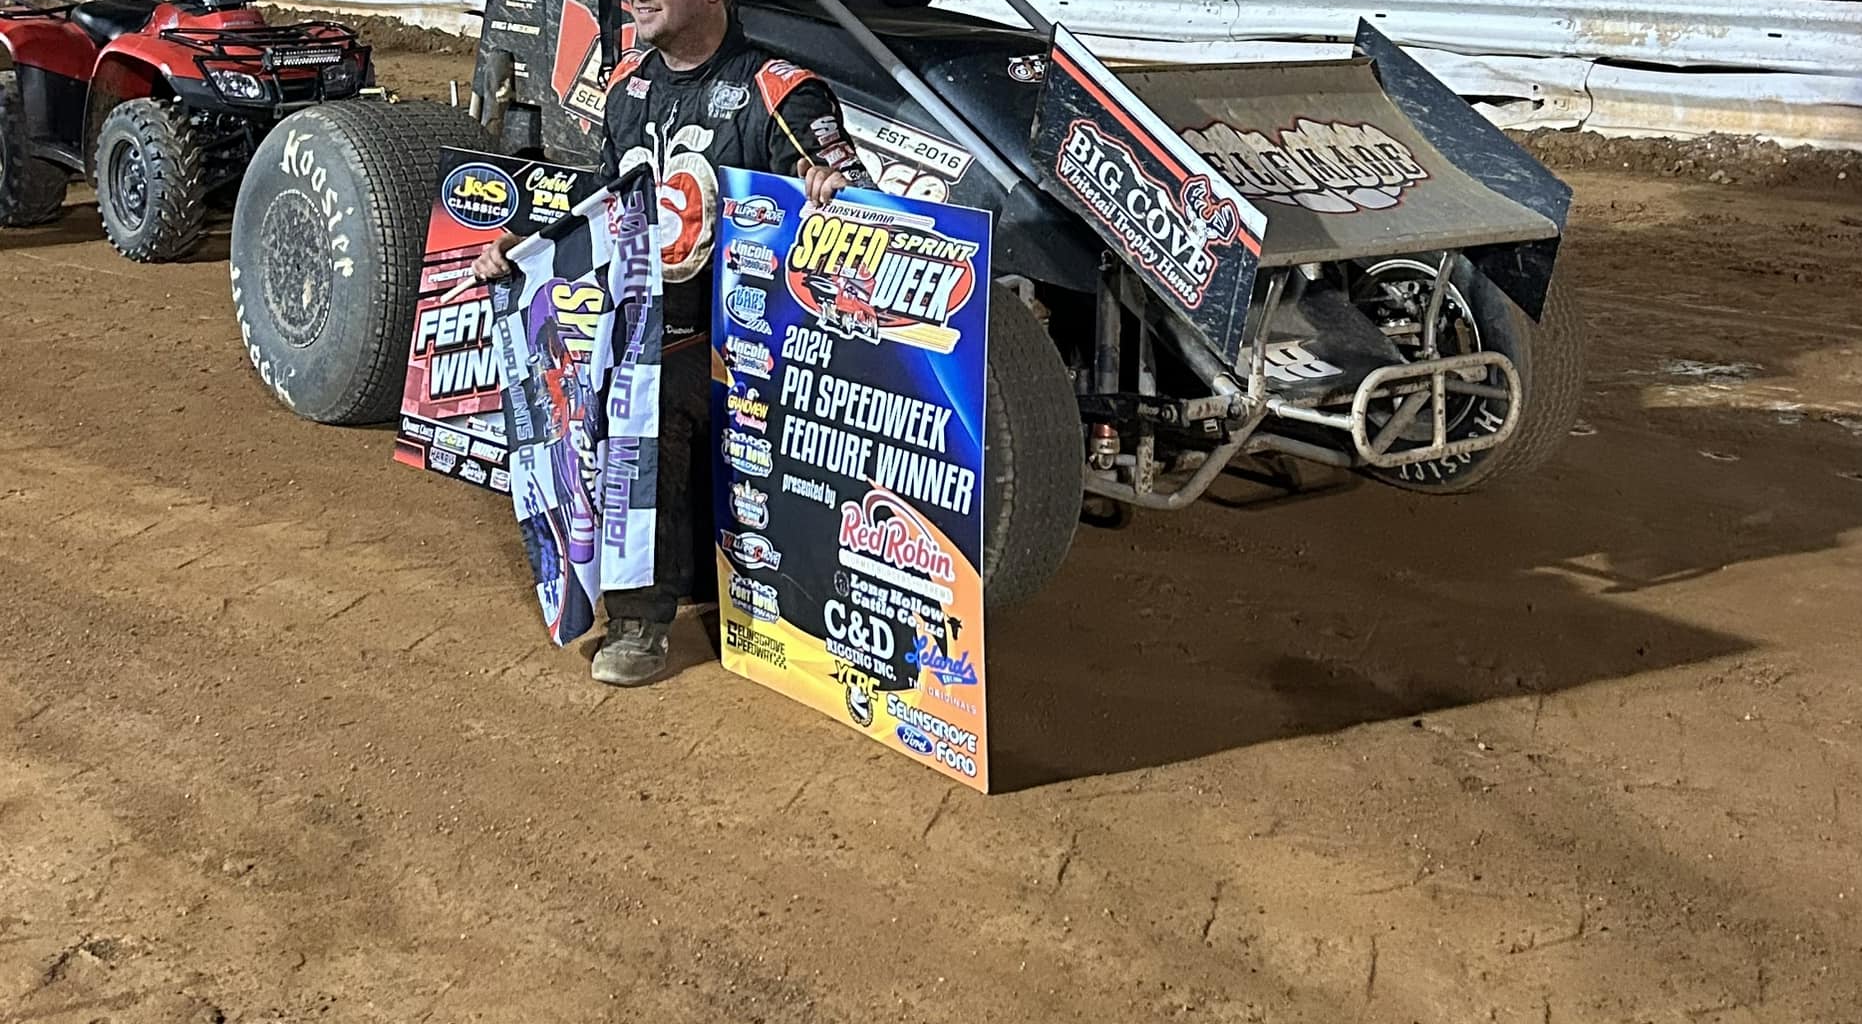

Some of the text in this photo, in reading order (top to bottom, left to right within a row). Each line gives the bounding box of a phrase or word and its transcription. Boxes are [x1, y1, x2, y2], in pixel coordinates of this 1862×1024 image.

[576, 89, 606, 113] SEL
[914, 142, 961, 169] 2016
[448, 197, 509, 219] CLASSICS
[454, 176, 508, 205] J&S
[532, 189, 570, 211] PA
[1066, 129, 1212, 284] BIG COVE
[792, 214, 977, 280] SPEED SPRINT
[1058, 156, 1199, 304] Whitetail Trophy Hunts
[870, 252, 967, 322] WEEK
[782, 325, 834, 369] 2024
[780, 364, 952, 454] PA SPEEDWEEK
[518, 444, 536, 471] OF
[780, 414, 976, 516] FEATURE WINNER
[604, 437, 640, 559] Winner
[781, 473, 837, 509] presented by
[841, 503, 884, 552] Red
[885, 520, 952, 578] Robin
[850, 573, 889, 601] Long
[890, 588, 945, 623] Hollow
[823, 598, 896, 660] C&D
[826, 637, 873, 670] RIGGING
[905, 634, 978, 677] Lelands
[887, 693, 978, 754] SELINSGROVE
[936, 740, 978, 777] FORD
